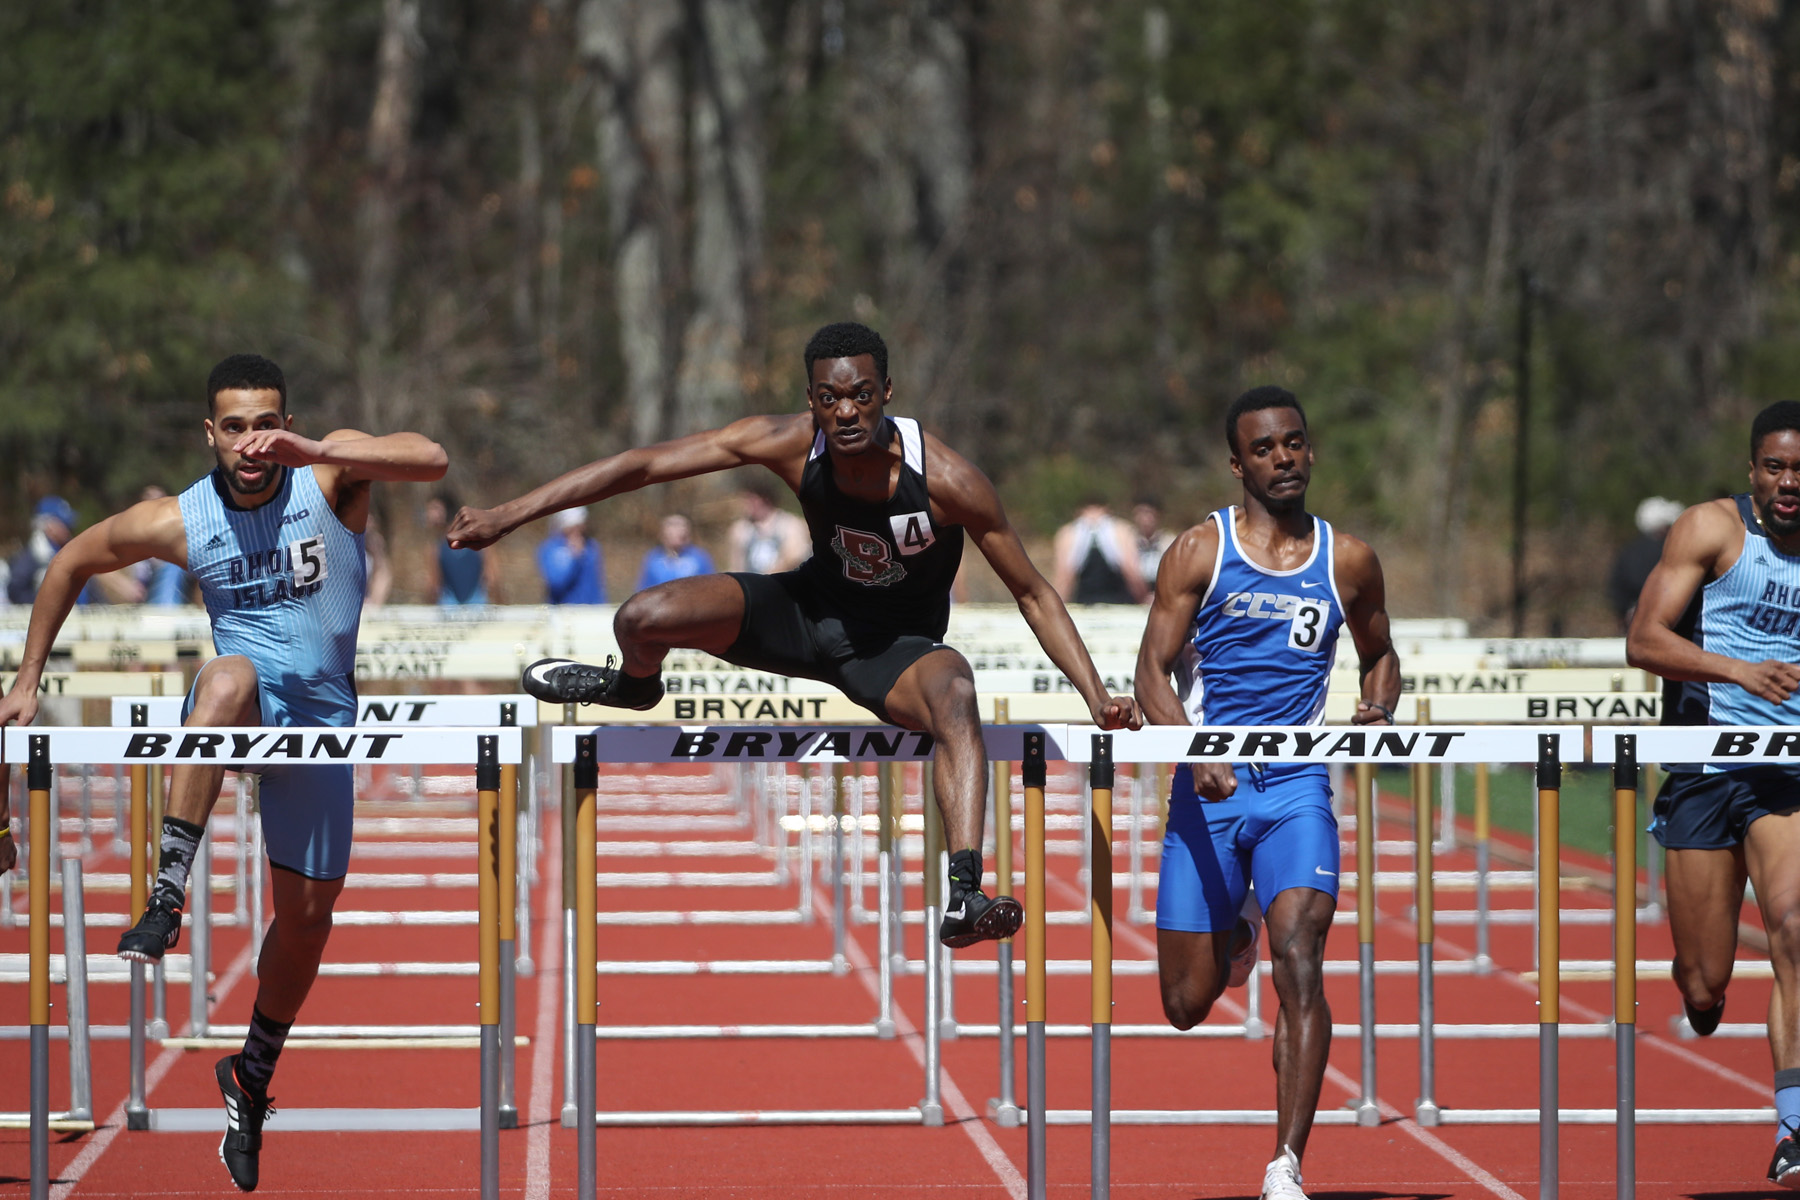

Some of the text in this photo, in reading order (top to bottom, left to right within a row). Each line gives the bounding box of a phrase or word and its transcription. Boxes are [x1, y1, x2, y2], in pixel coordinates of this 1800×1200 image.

[904, 516, 929, 549] 4
[229, 546, 294, 586] RHO
[300, 539, 321, 583] 5
[1294, 606, 1320, 647] 3
[1745, 604, 1800, 638] ISLA
[356, 658, 447, 677] RYANT
[666, 676, 792, 692] BRYANT
[1401, 674, 1527, 692] BRYANT
[674, 699, 827, 719] BRYANT
[1527, 698, 1663, 718] BRYAN
[124, 733, 403, 758] BRYANT
[670, 731, 936, 757] BRYANT
[1186, 732, 1466, 757] BRYANT
